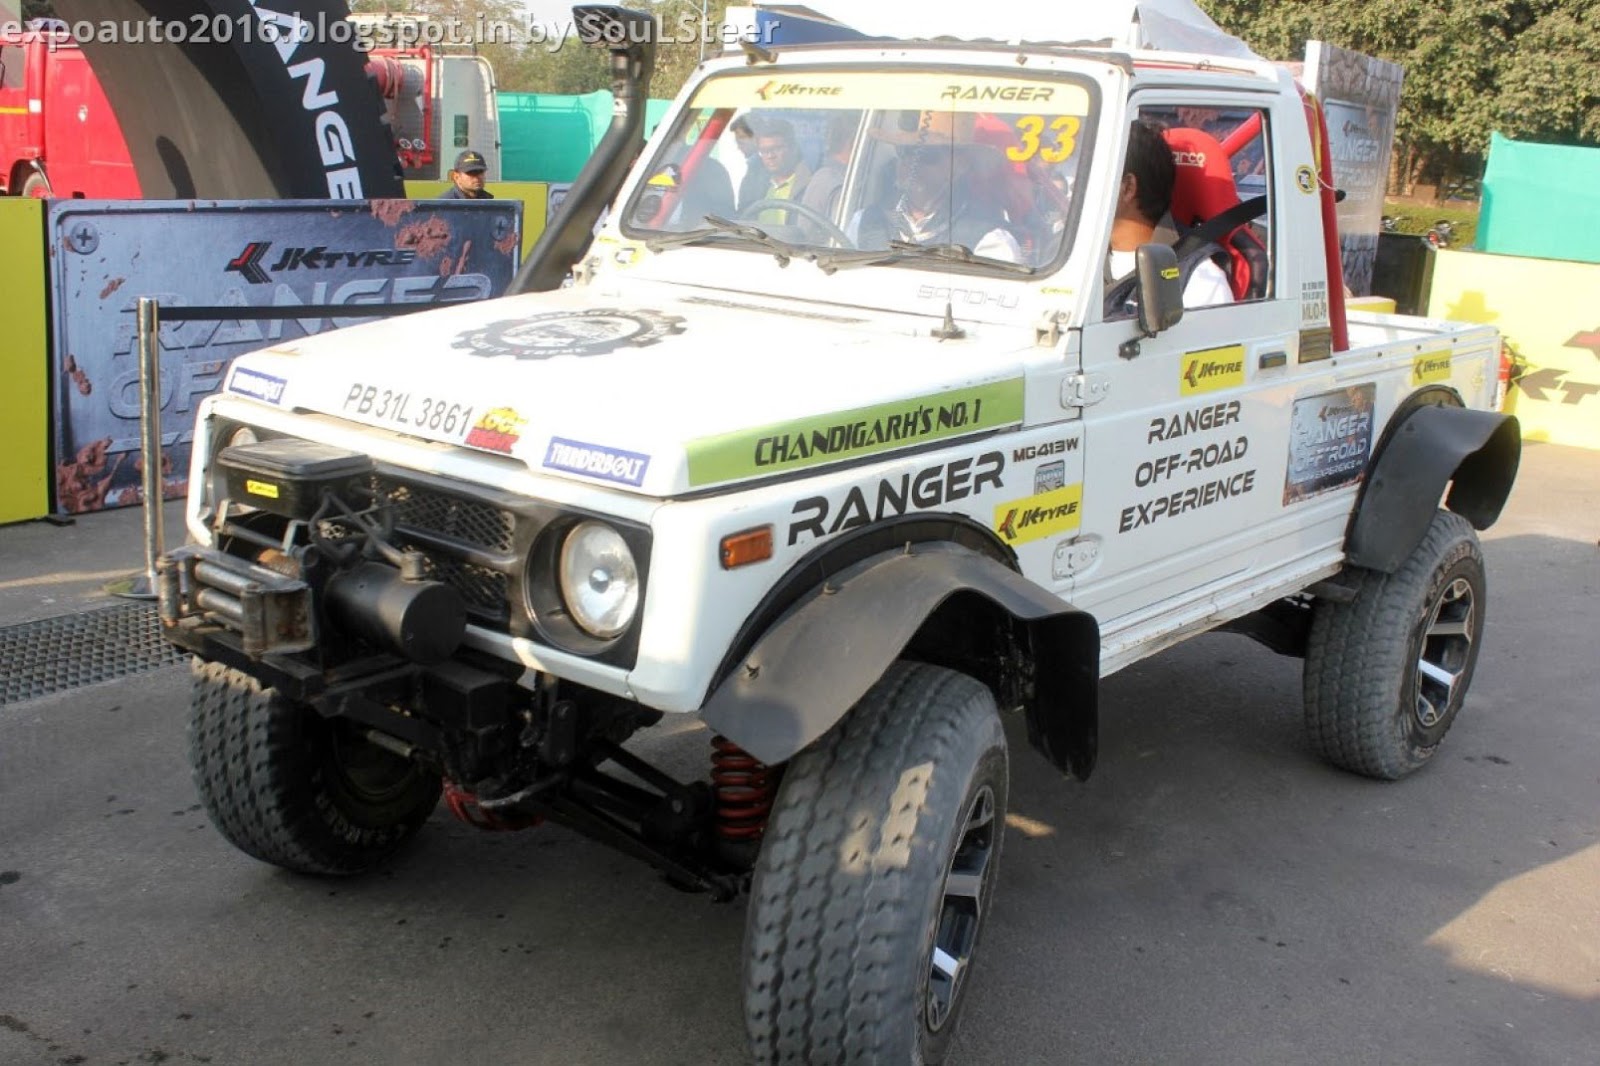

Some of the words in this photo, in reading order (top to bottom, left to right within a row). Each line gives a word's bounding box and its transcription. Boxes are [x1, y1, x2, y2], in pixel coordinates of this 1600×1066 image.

[248, 0, 364, 199] ANGE
[941, 85, 1055, 102] RANGER
[1005, 114, 1081, 164] 33
[415, 397, 474, 437] 3861
[755, 404, 934, 467] CHANDIGARH'S
[1147, 399, 1242, 445] RANGER
[1013, 437, 1080, 463] MG413W
[1135, 435, 1249, 488] OFF-ROAD
[787, 450, 1006, 547] RANGER
[1118, 469, 1257, 534] EXPERIENCE
